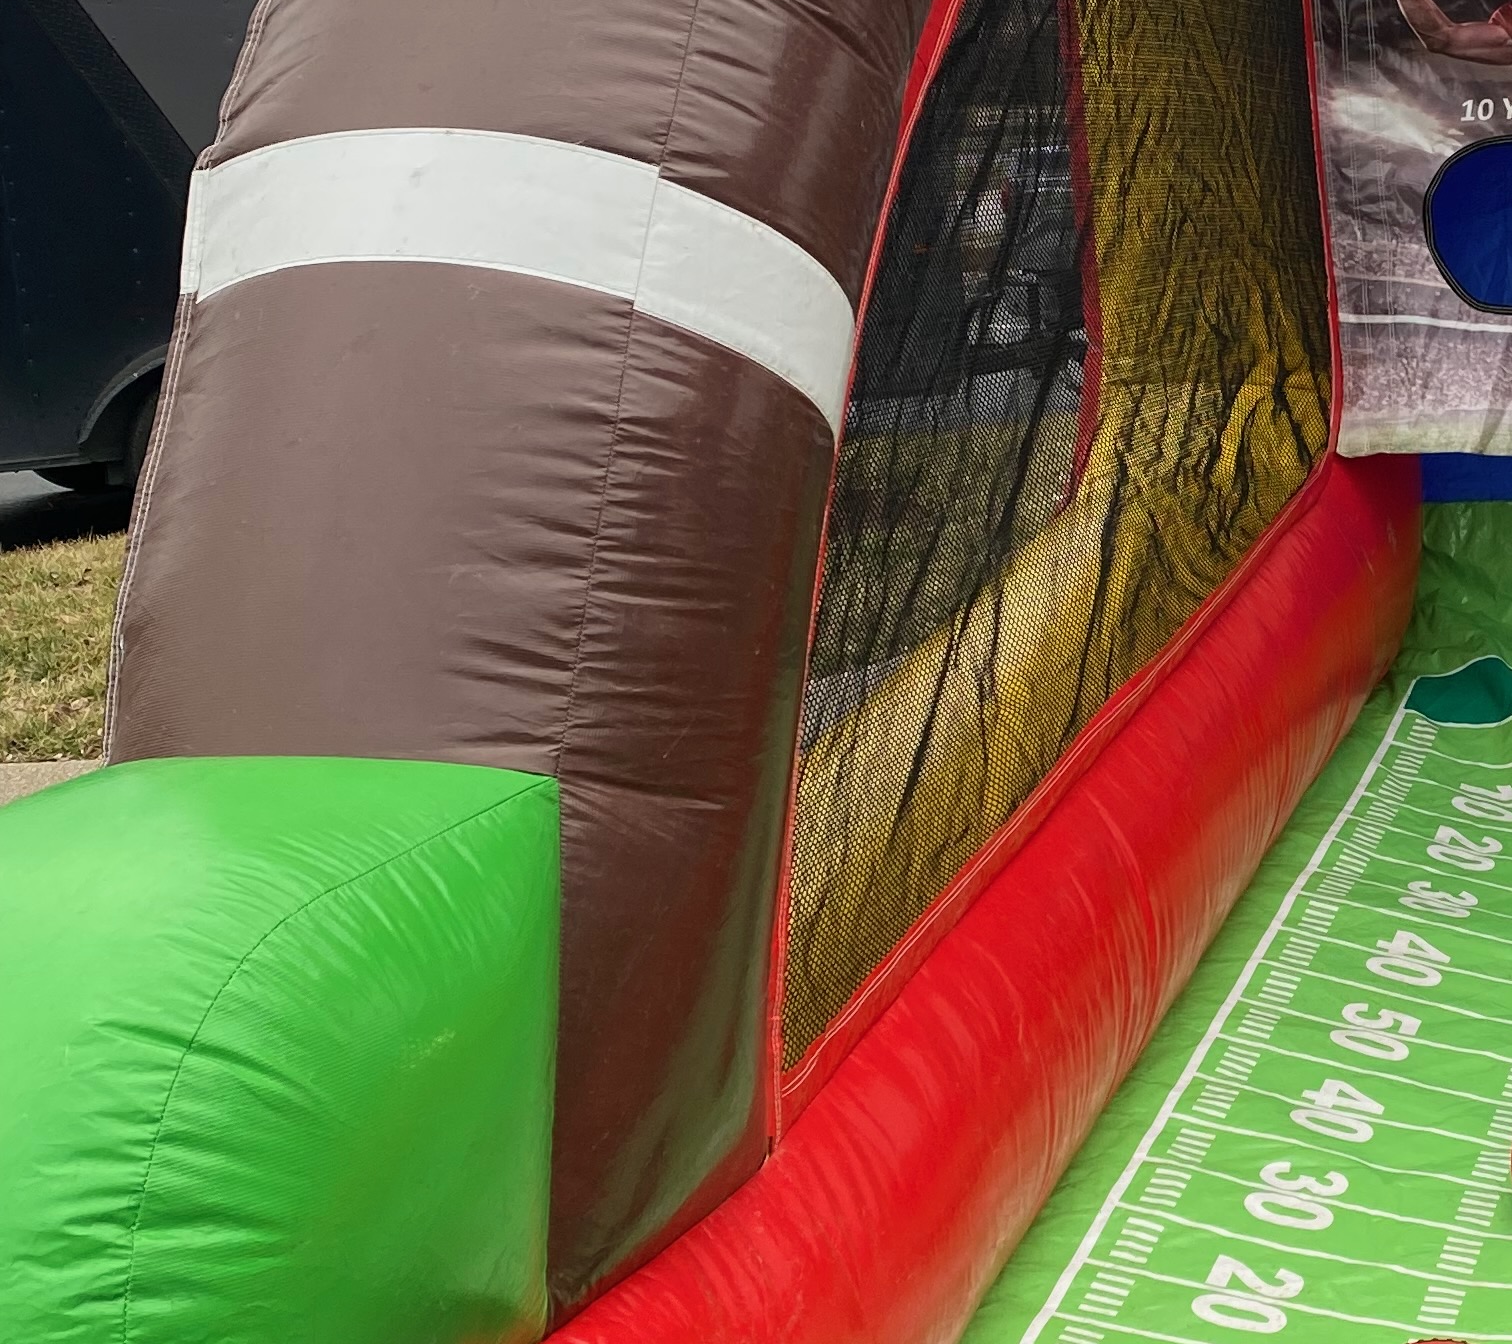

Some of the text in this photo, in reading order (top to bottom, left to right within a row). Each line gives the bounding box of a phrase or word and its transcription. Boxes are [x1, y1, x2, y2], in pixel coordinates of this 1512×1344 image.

[1460, 98, 1495, 122] 10
[1426, 824, 1503, 872] 20
[1397, 880, 1479, 918] 30
[1365, 929, 1452, 988] 40
[1329, 1001, 1423, 1062] 50
[1289, 1078, 1386, 1144] 40
[1243, 1160, 1350, 1231] 30
[1191, 1254, 1305, 1335] 20
